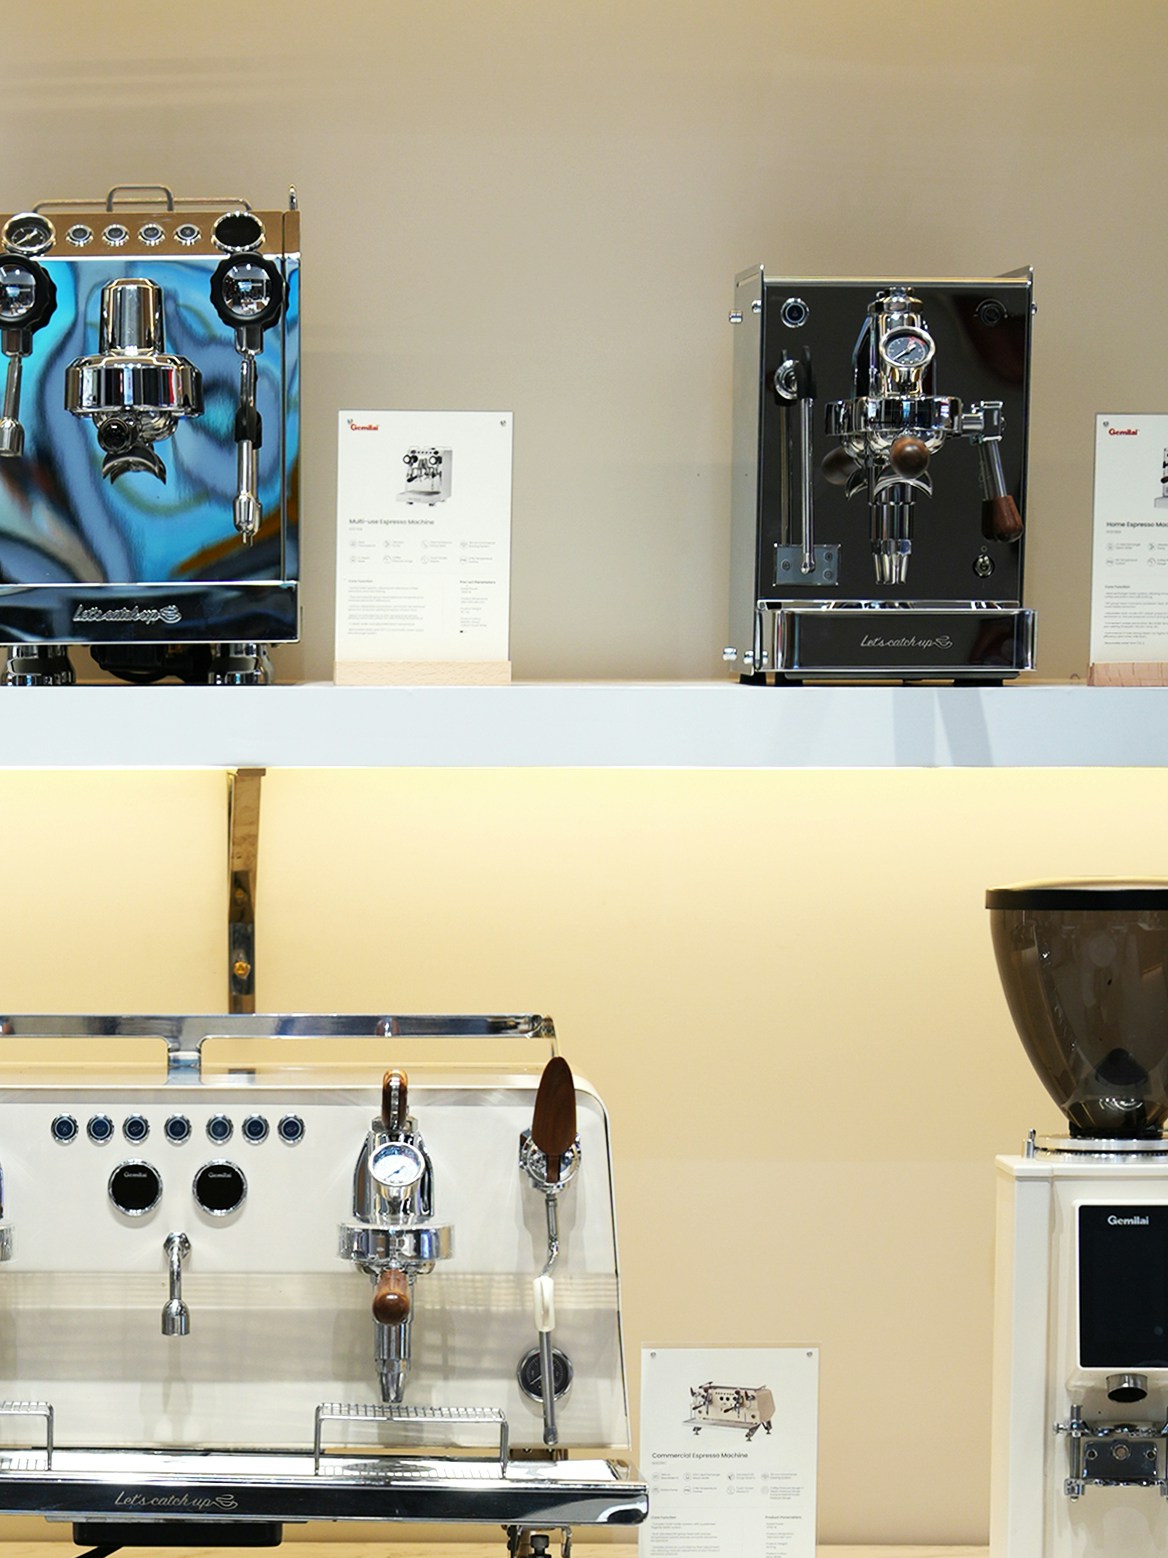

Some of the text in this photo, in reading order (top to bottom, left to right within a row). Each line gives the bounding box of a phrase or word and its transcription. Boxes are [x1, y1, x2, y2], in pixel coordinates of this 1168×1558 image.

[860, 634, 932, 649] Let's catch up
[1107, 1214, 1150, 1226] Gemilai
[692, 1452, 720, 1460] Espresso
[114, 1491, 212, 1510] Let's catch up
